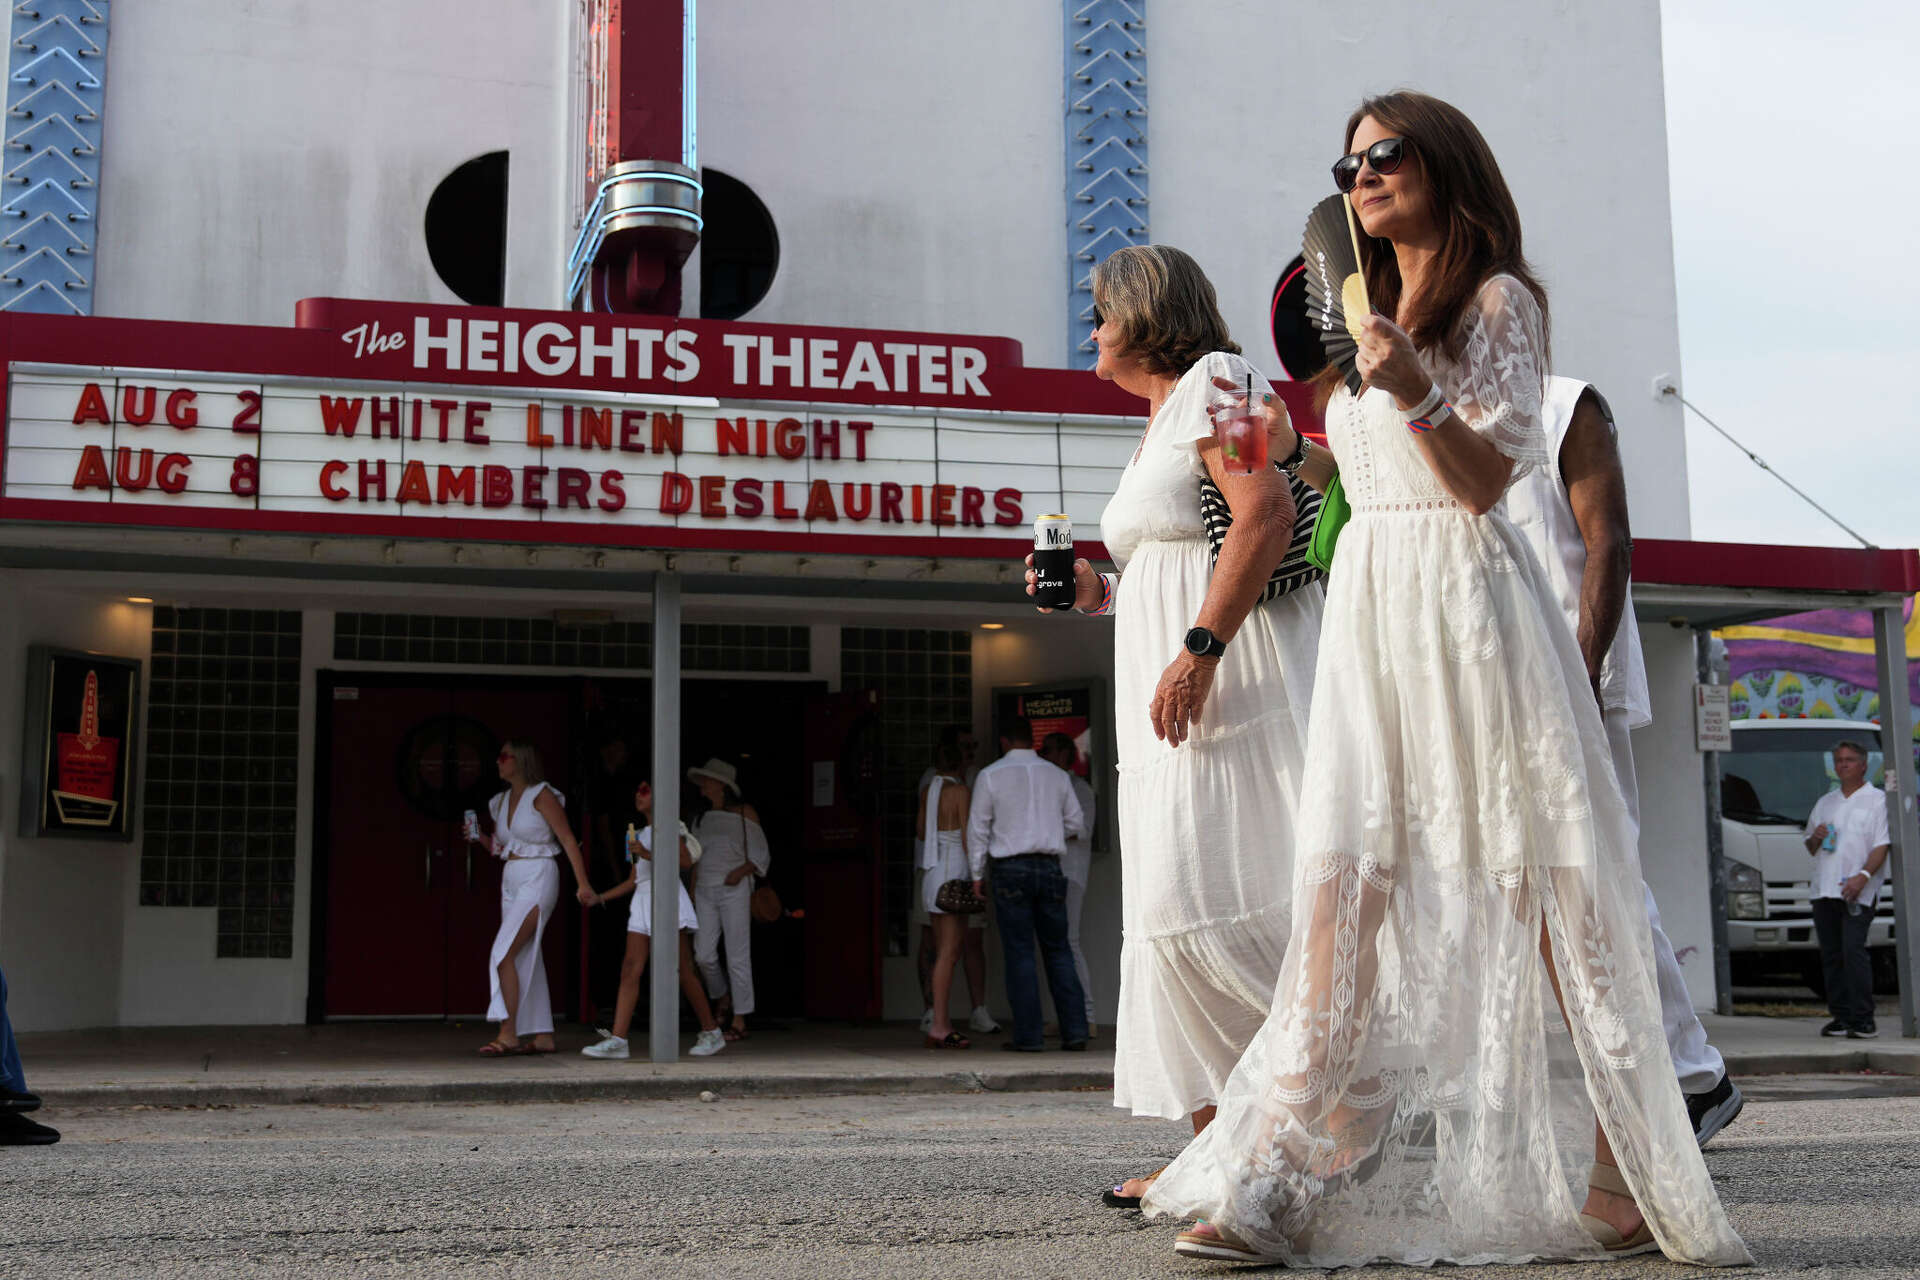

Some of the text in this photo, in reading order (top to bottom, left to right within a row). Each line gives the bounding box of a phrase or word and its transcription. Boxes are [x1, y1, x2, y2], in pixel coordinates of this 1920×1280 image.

[341, 316, 992, 397] The HEIGHTS THEATER
[72, 383, 873, 461] AUG 2 WHITE LINEN NIGHT
[72, 445, 1024, 527] AUG 8 CHAMBERS DESLAURIERS
